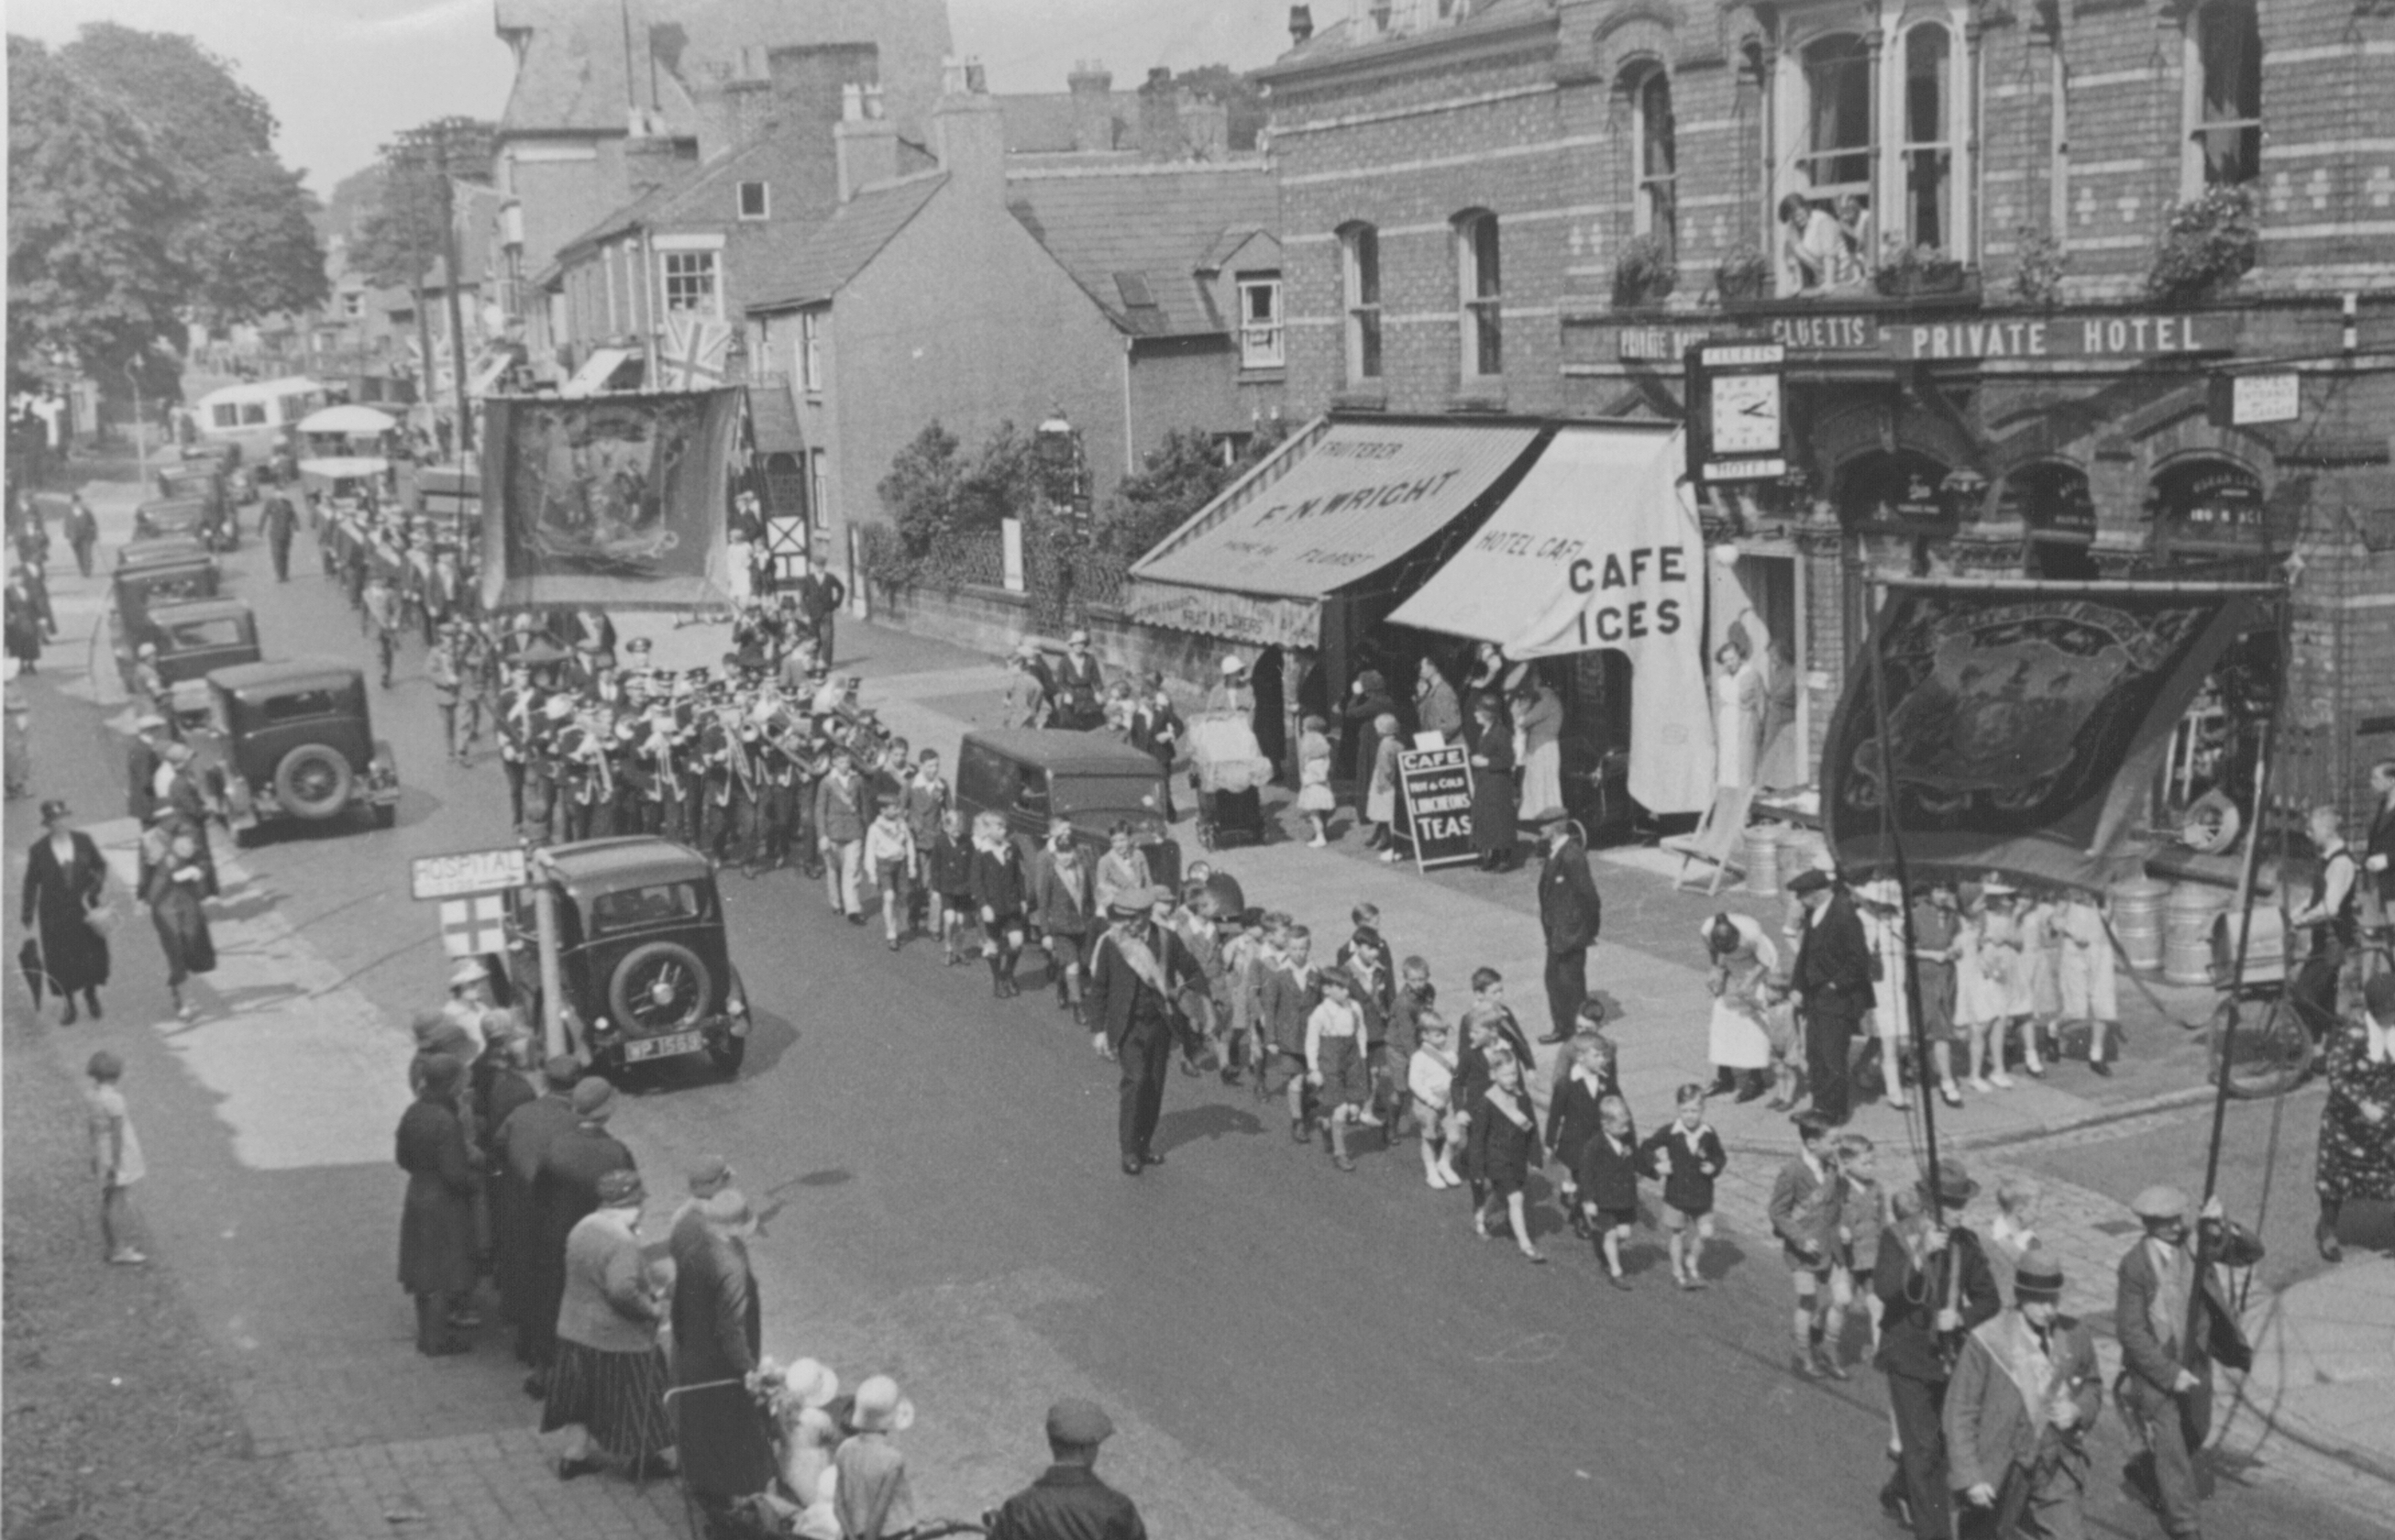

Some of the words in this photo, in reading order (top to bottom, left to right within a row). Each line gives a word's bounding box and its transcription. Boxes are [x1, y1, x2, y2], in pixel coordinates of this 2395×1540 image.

[1771, 317, 1865, 348] CLUETTS
[1910, 322, 2047, 359] PRIVATE
[2082, 315, 2202, 354] HOTEL
[1716, 459, 1770, 476] HOTEL
[1475, 530, 1536, 556] HOTEL
[1568, 545, 1687, 595] CAFE
[1577, 598, 1683, 647] ICES
[1404, 750, 1462, 769] CAFE
[1418, 814, 1472, 841] TEAS
[414, 852, 524, 883] HOSPITAL
